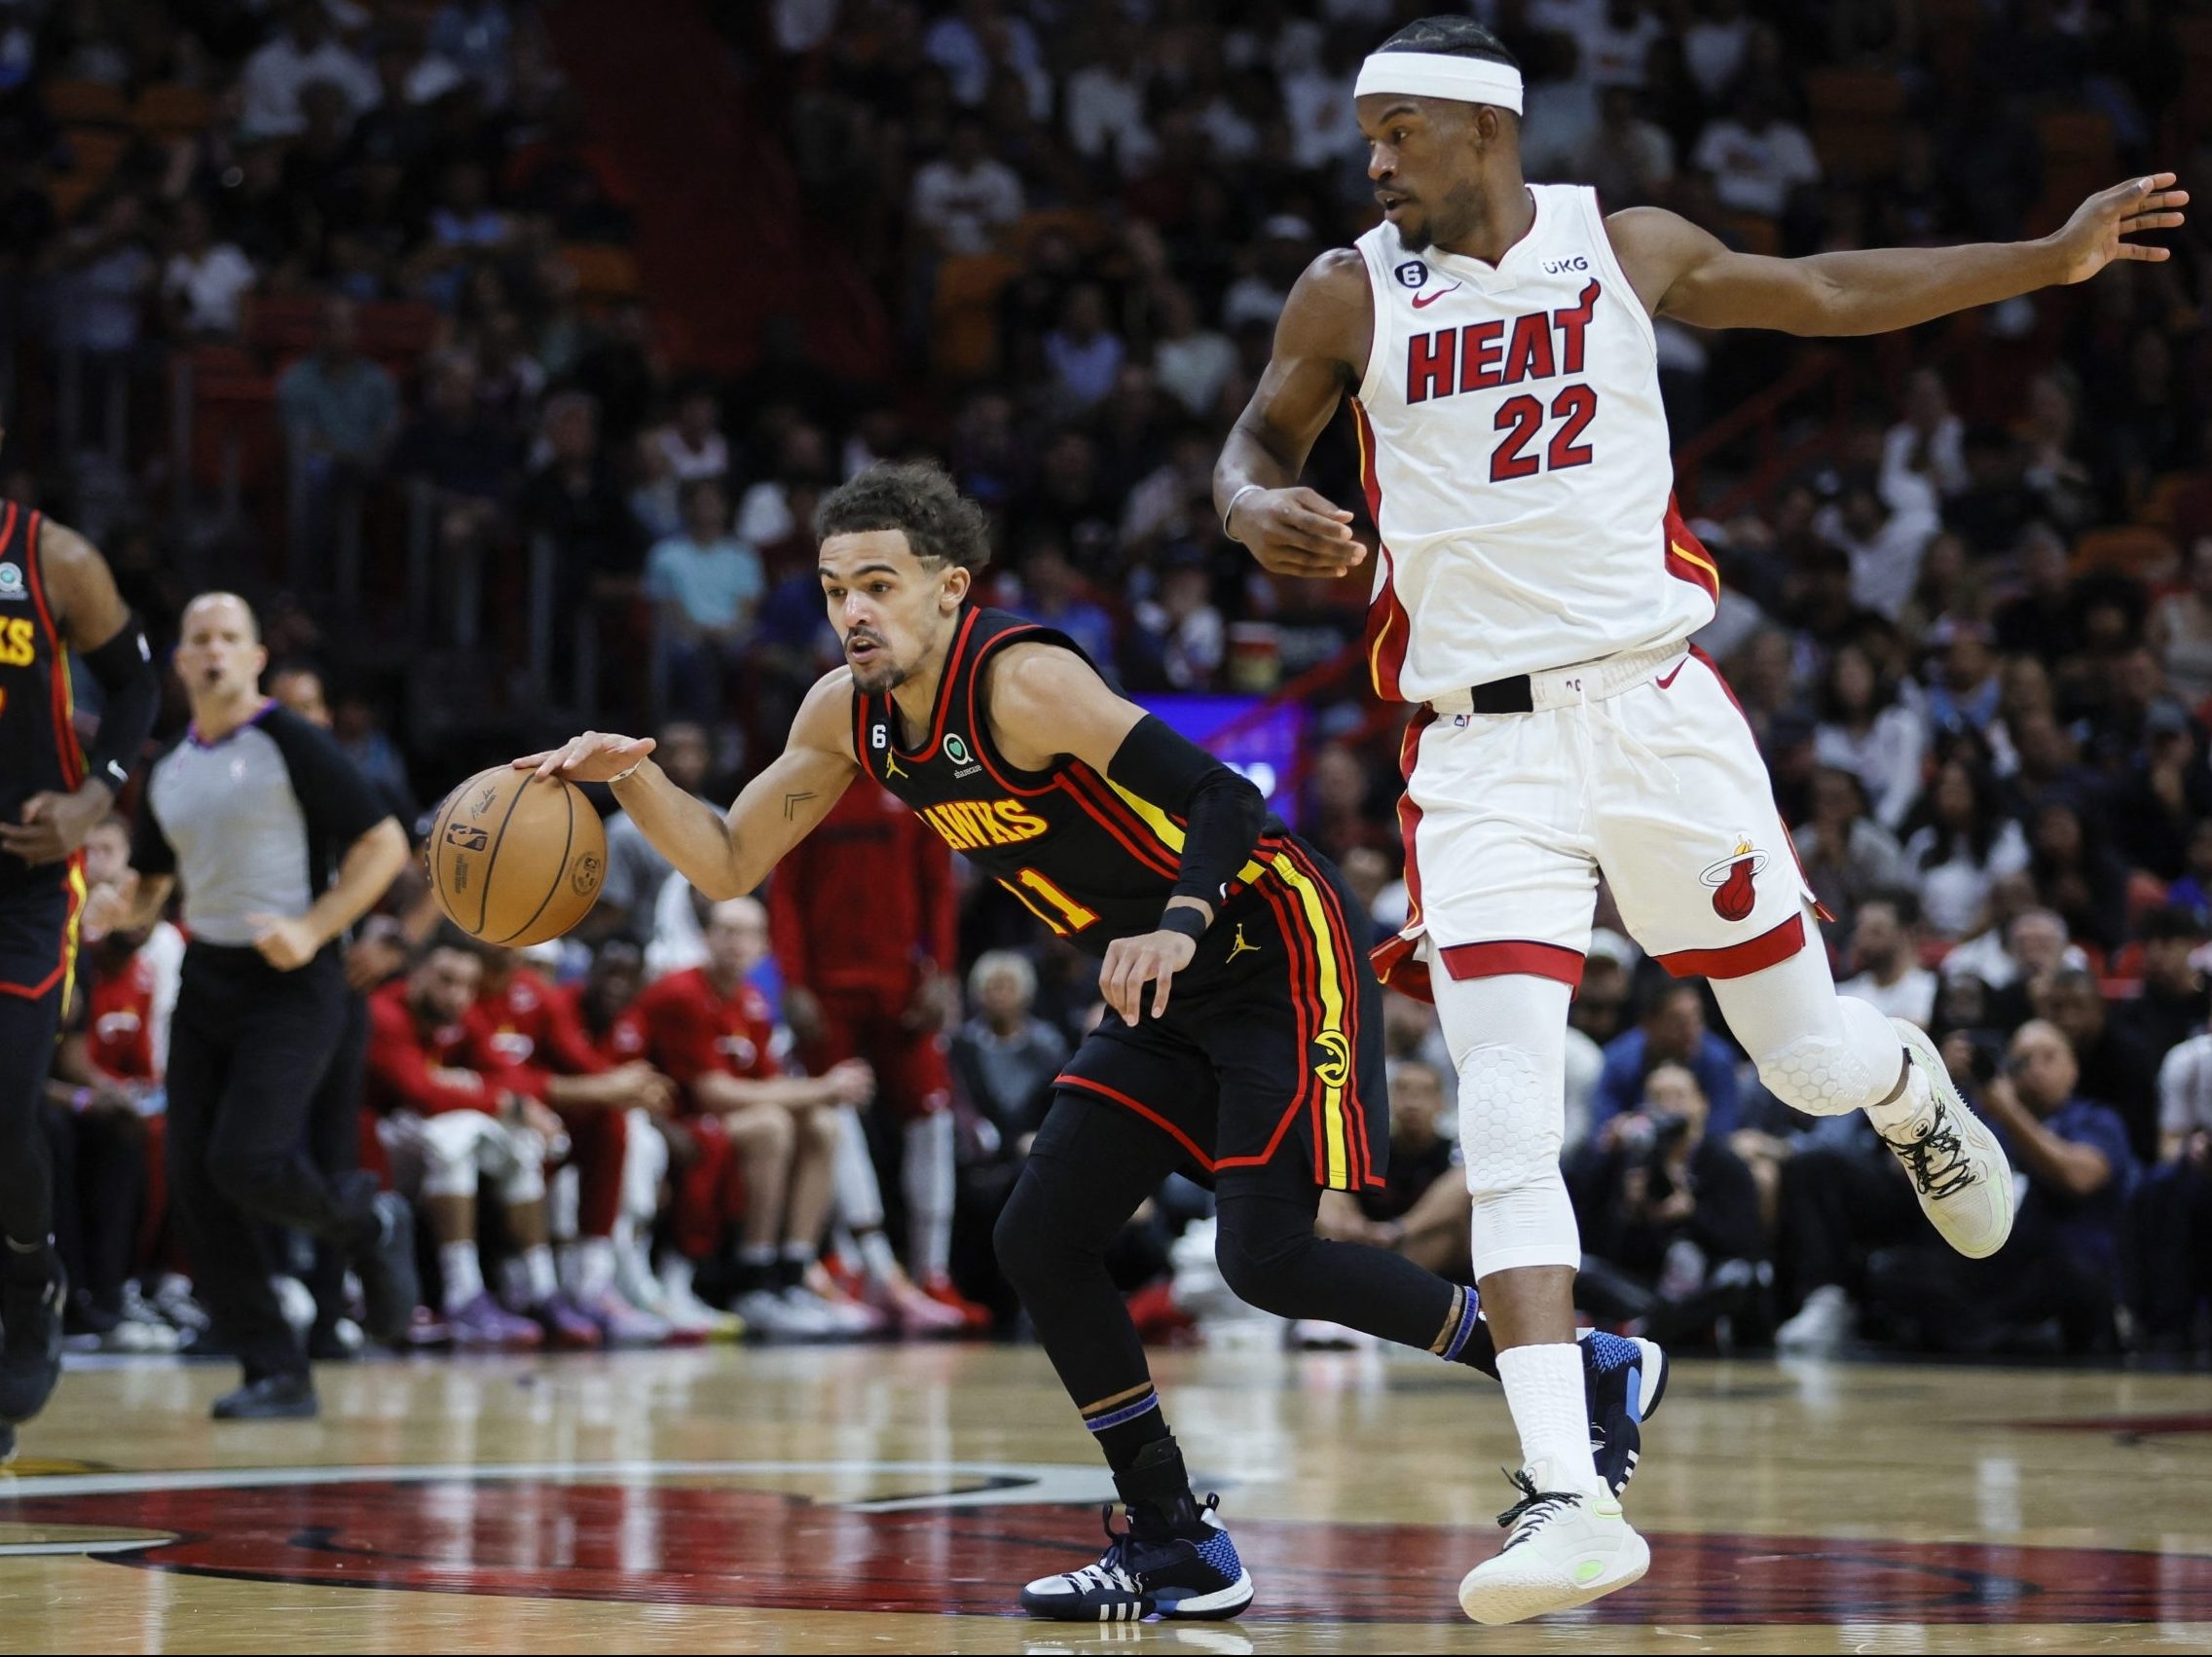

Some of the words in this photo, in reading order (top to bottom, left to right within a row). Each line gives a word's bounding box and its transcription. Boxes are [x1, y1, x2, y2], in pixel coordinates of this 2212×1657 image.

[1401, 265, 1421, 286] 6
[1407, 277, 1601, 405] HEAT
[1490, 384, 1598, 483] 22
[872, 724, 887, 749] 6
[913, 798, 1049, 850] AWKS
